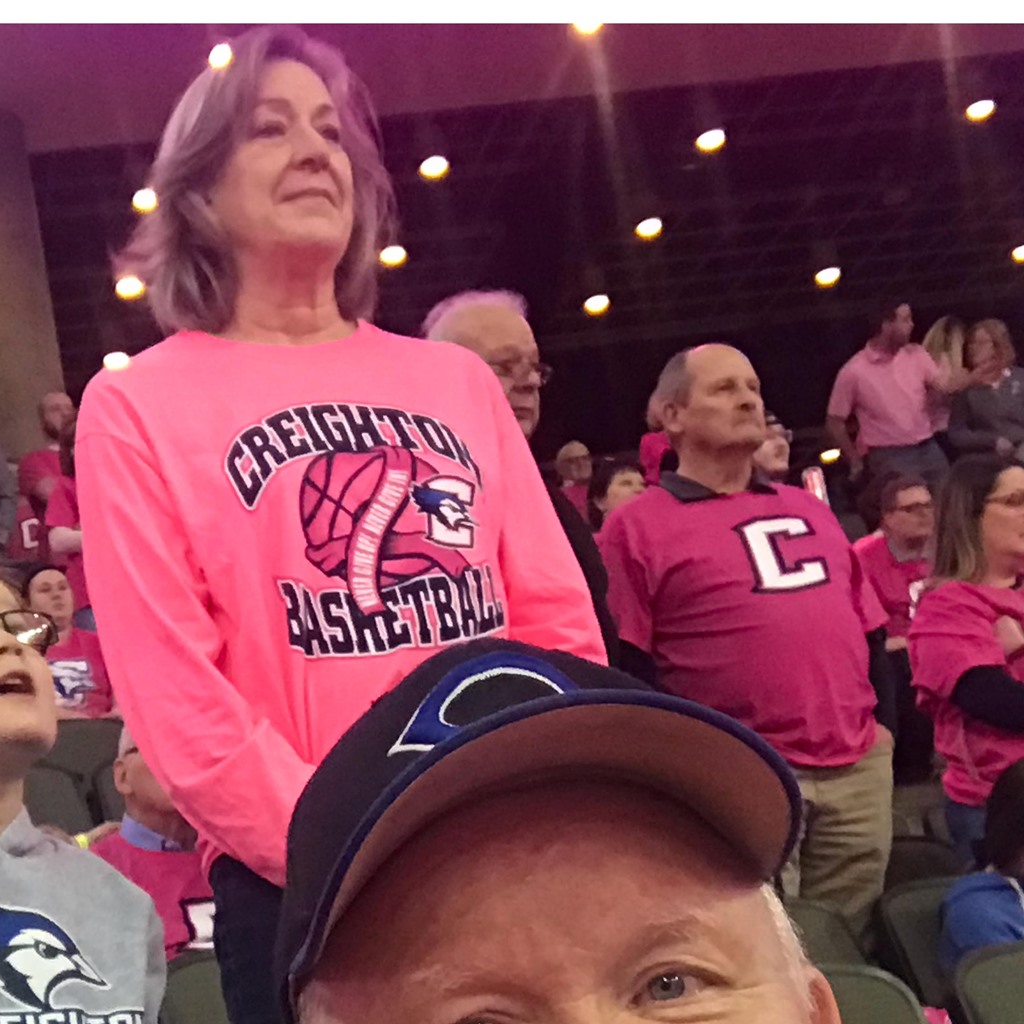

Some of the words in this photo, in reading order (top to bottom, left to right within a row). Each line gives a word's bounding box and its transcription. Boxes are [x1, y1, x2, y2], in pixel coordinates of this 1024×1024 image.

[225, 402, 483, 512] CREIGHTON
[734, 516, 829, 593] C
[277, 563, 505, 657] BASKETBALL
